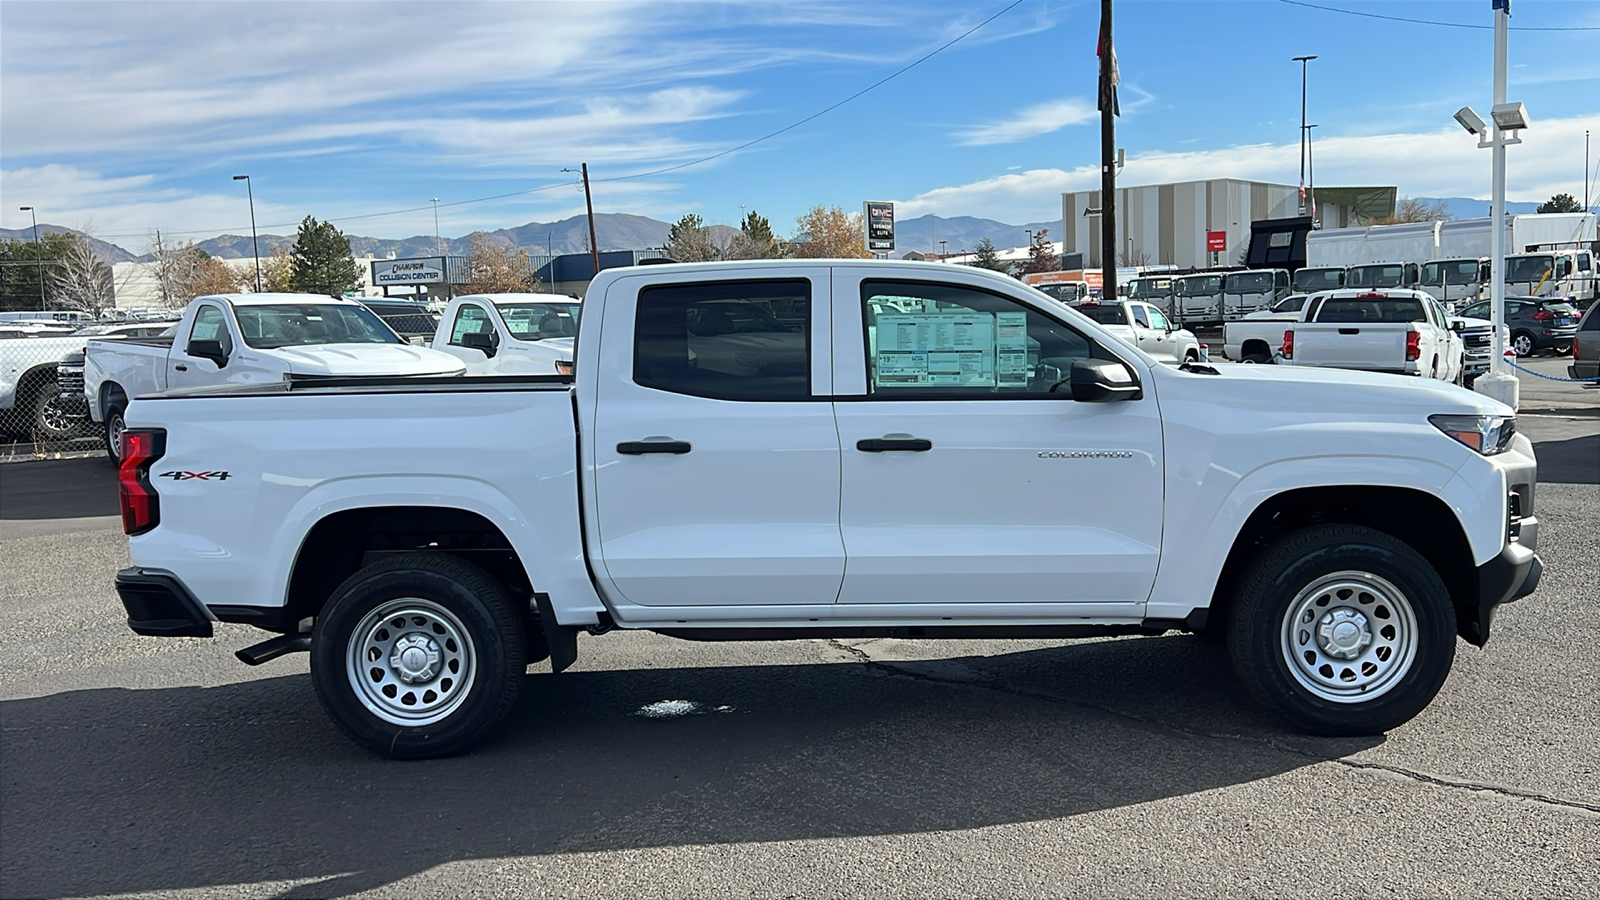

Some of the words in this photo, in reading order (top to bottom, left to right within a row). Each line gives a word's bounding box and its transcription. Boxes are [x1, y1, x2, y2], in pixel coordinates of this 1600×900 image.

[392, 263, 424, 273] CHAMPION
[379, 273, 412, 281] COLLISION
[412, 272, 439, 280] CENTER
